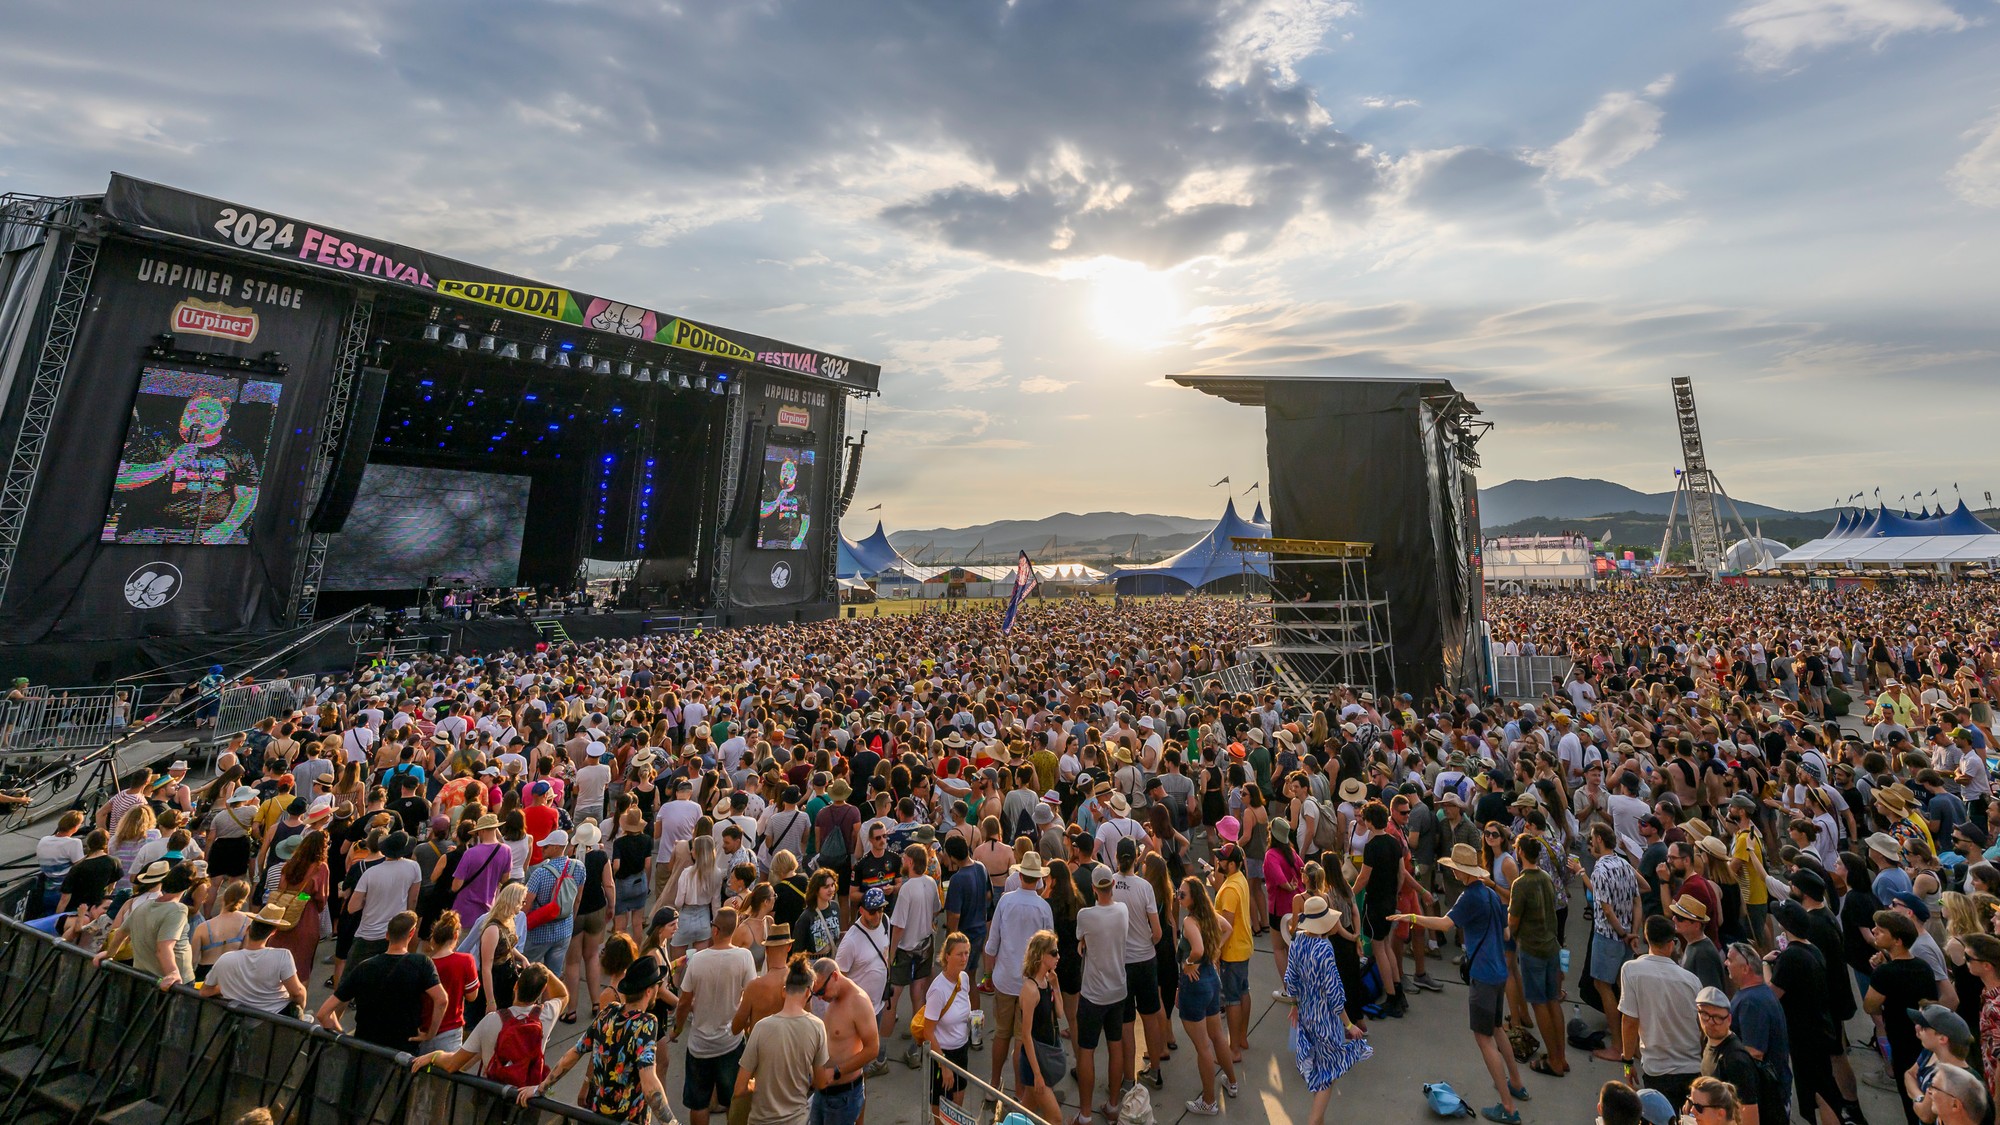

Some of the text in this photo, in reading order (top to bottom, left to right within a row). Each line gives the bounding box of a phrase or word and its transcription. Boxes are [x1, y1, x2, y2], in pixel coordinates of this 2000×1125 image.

[214, 208, 560, 317] 2024 FESTIVAL POHODA
[137, 258, 304, 310] URPINER STAGE
[181, 309, 251, 333] Urpiner
[676, 321, 850, 379] POHODA FESTIVAL 2024
[764, 383, 826, 407] URPINER STAGE
[781, 412, 807, 424] Urpiner
